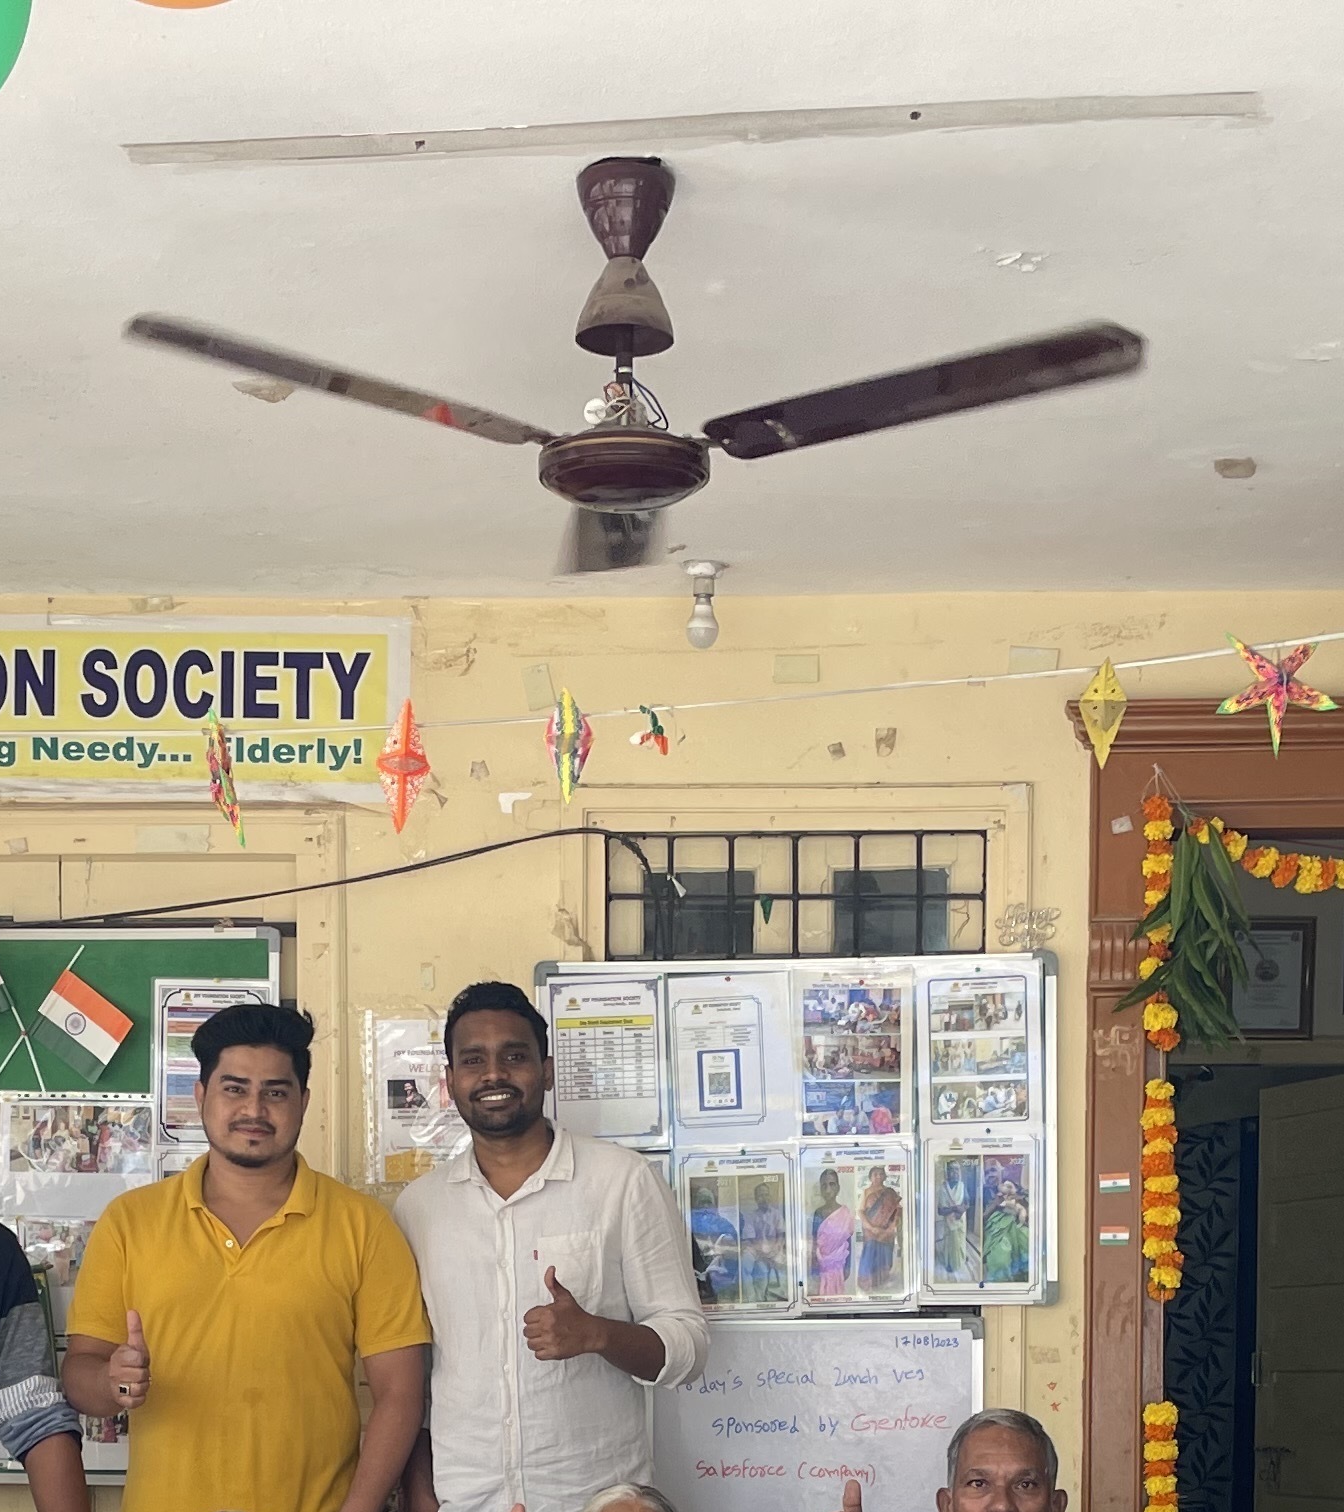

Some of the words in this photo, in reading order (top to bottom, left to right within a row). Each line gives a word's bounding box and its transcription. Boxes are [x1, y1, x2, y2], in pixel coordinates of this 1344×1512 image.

[80, 648, 371, 719] SOCIETY
[32, 736, 192, 768] Needy...
[225, 738, 362, 770] lderly!
[408, 1063, 446, 1073] WELCO
[895, 1334, 960, 1349] 17/08/2023
[819, 1415, 839, 1437] by
